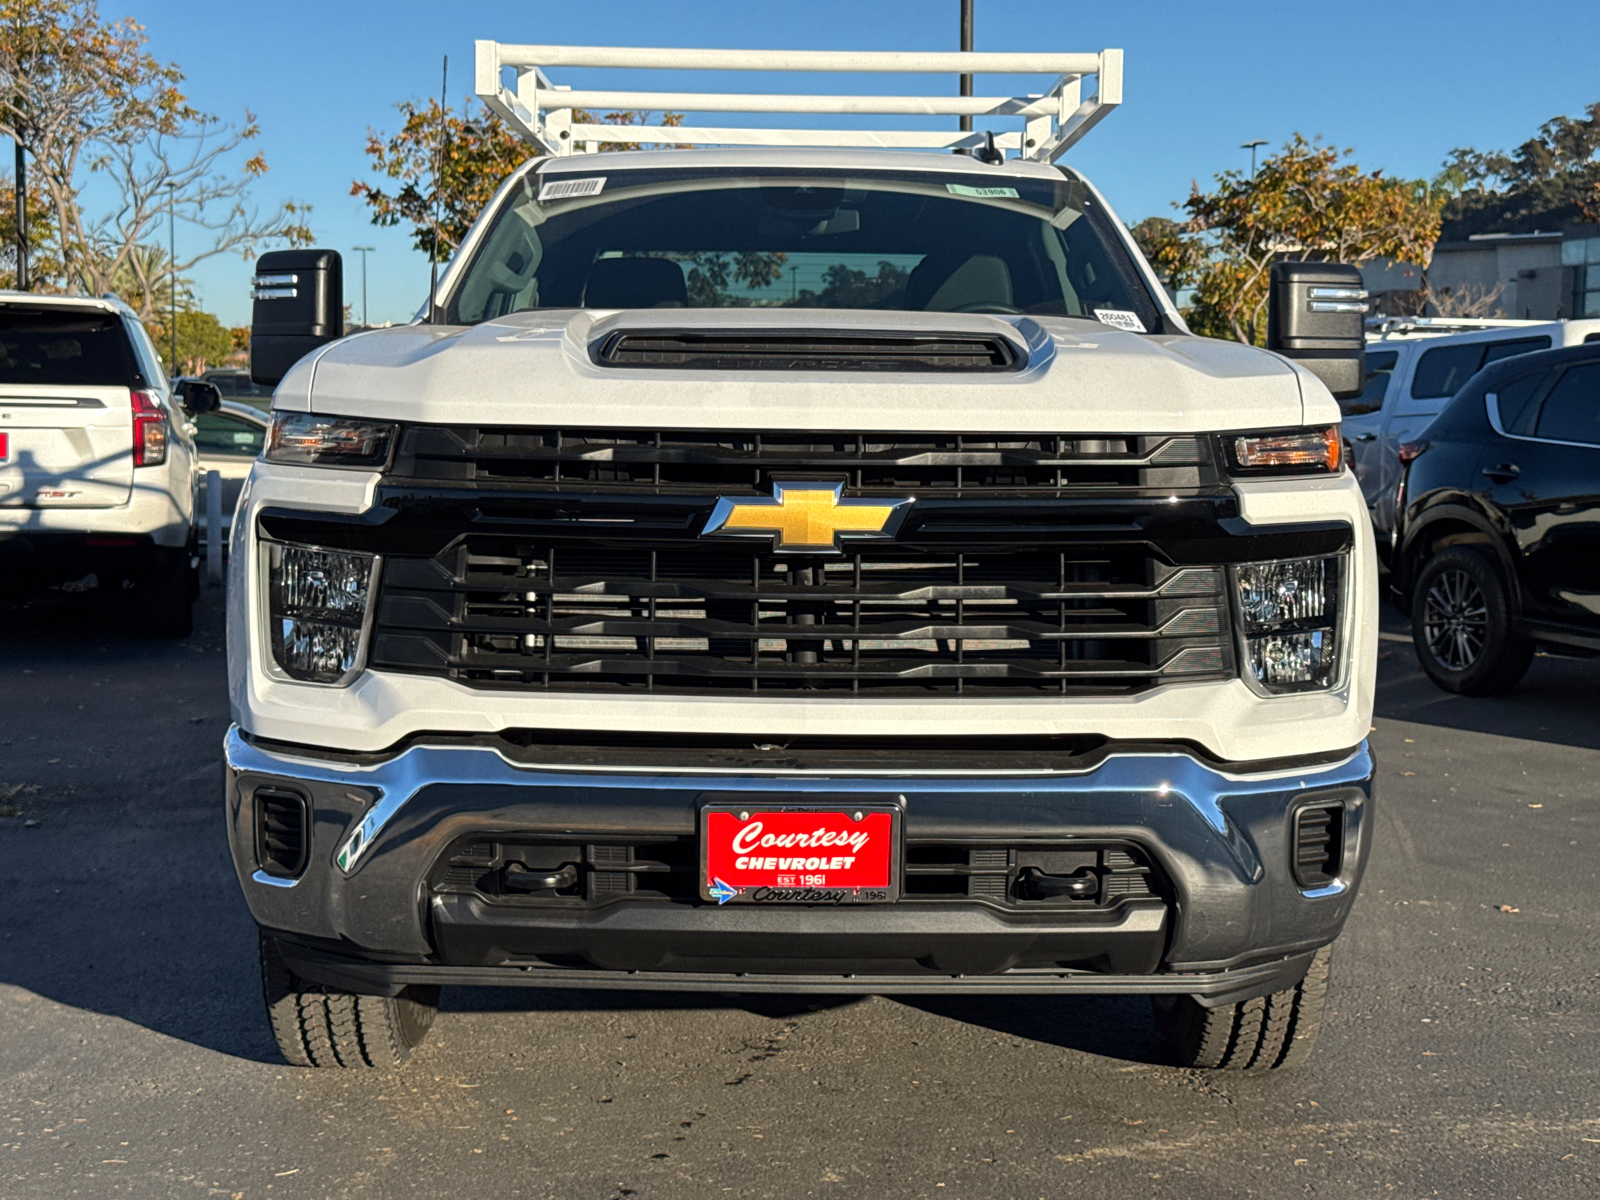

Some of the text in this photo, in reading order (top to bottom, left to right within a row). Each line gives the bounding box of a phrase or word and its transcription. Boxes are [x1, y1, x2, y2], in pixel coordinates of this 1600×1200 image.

[732, 821, 870, 854] Courtesy
[735, 856, 856, 870] CHEVROLET
[777, 874, 826, 885] EST 1961
[752, 886, 886, 905] Courtesy 1961
